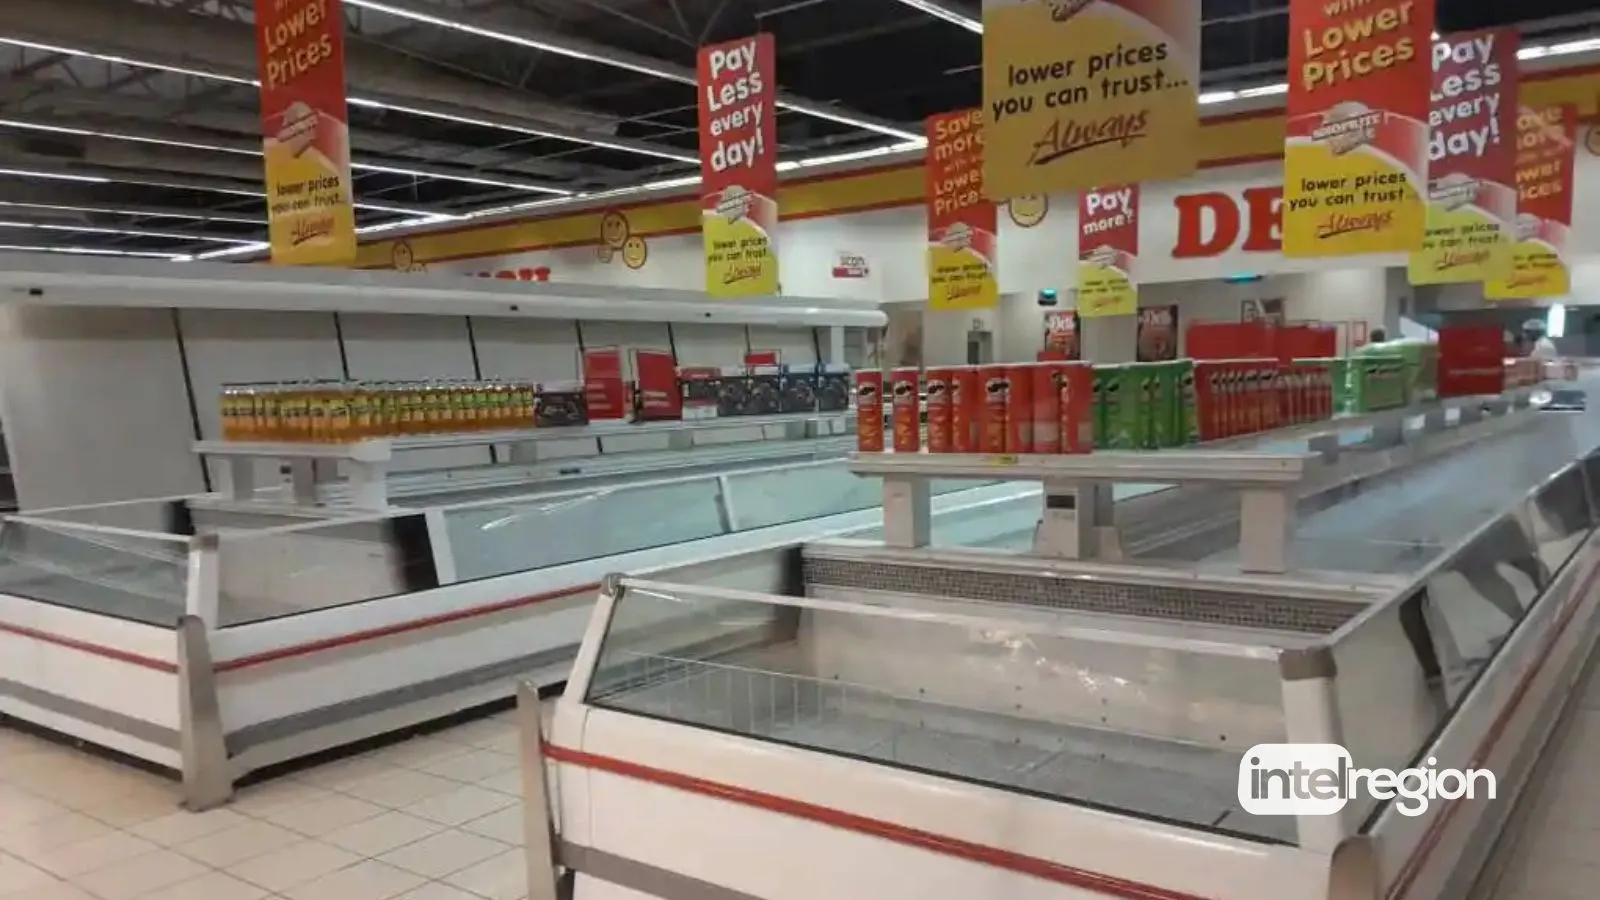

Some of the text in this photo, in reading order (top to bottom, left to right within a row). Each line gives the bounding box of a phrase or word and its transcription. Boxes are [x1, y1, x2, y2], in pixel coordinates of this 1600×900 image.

[264, 0, 327, 54] Lower
[1304, 1, 1413, 59] Lower
[266, 33, 333, 91] Prices
[709, 40, 757, 79] Pay
[1008, 43, 1168, 87] lower prices
[1303, 37, 1414, 92] Prices
[1431, 33, 1495, 71] Pay
[707, 71, 763, 112] Less
[992, 68, 1189, 123] you can trust...
[1429, 92, 1500, 126] every
[710, 100, 764, 136] every
[935, 110, 983, 140] Save
[1025, 110, 1149, 167] Always
[1429, 117, 1500, 160] day!
[711, 127, 764, 172] day!
[1086, 186, 1132, 216] Pay
[1289, 188, 1404, 211] you can trust
[1301, 172, 1407, 192] lower prices
